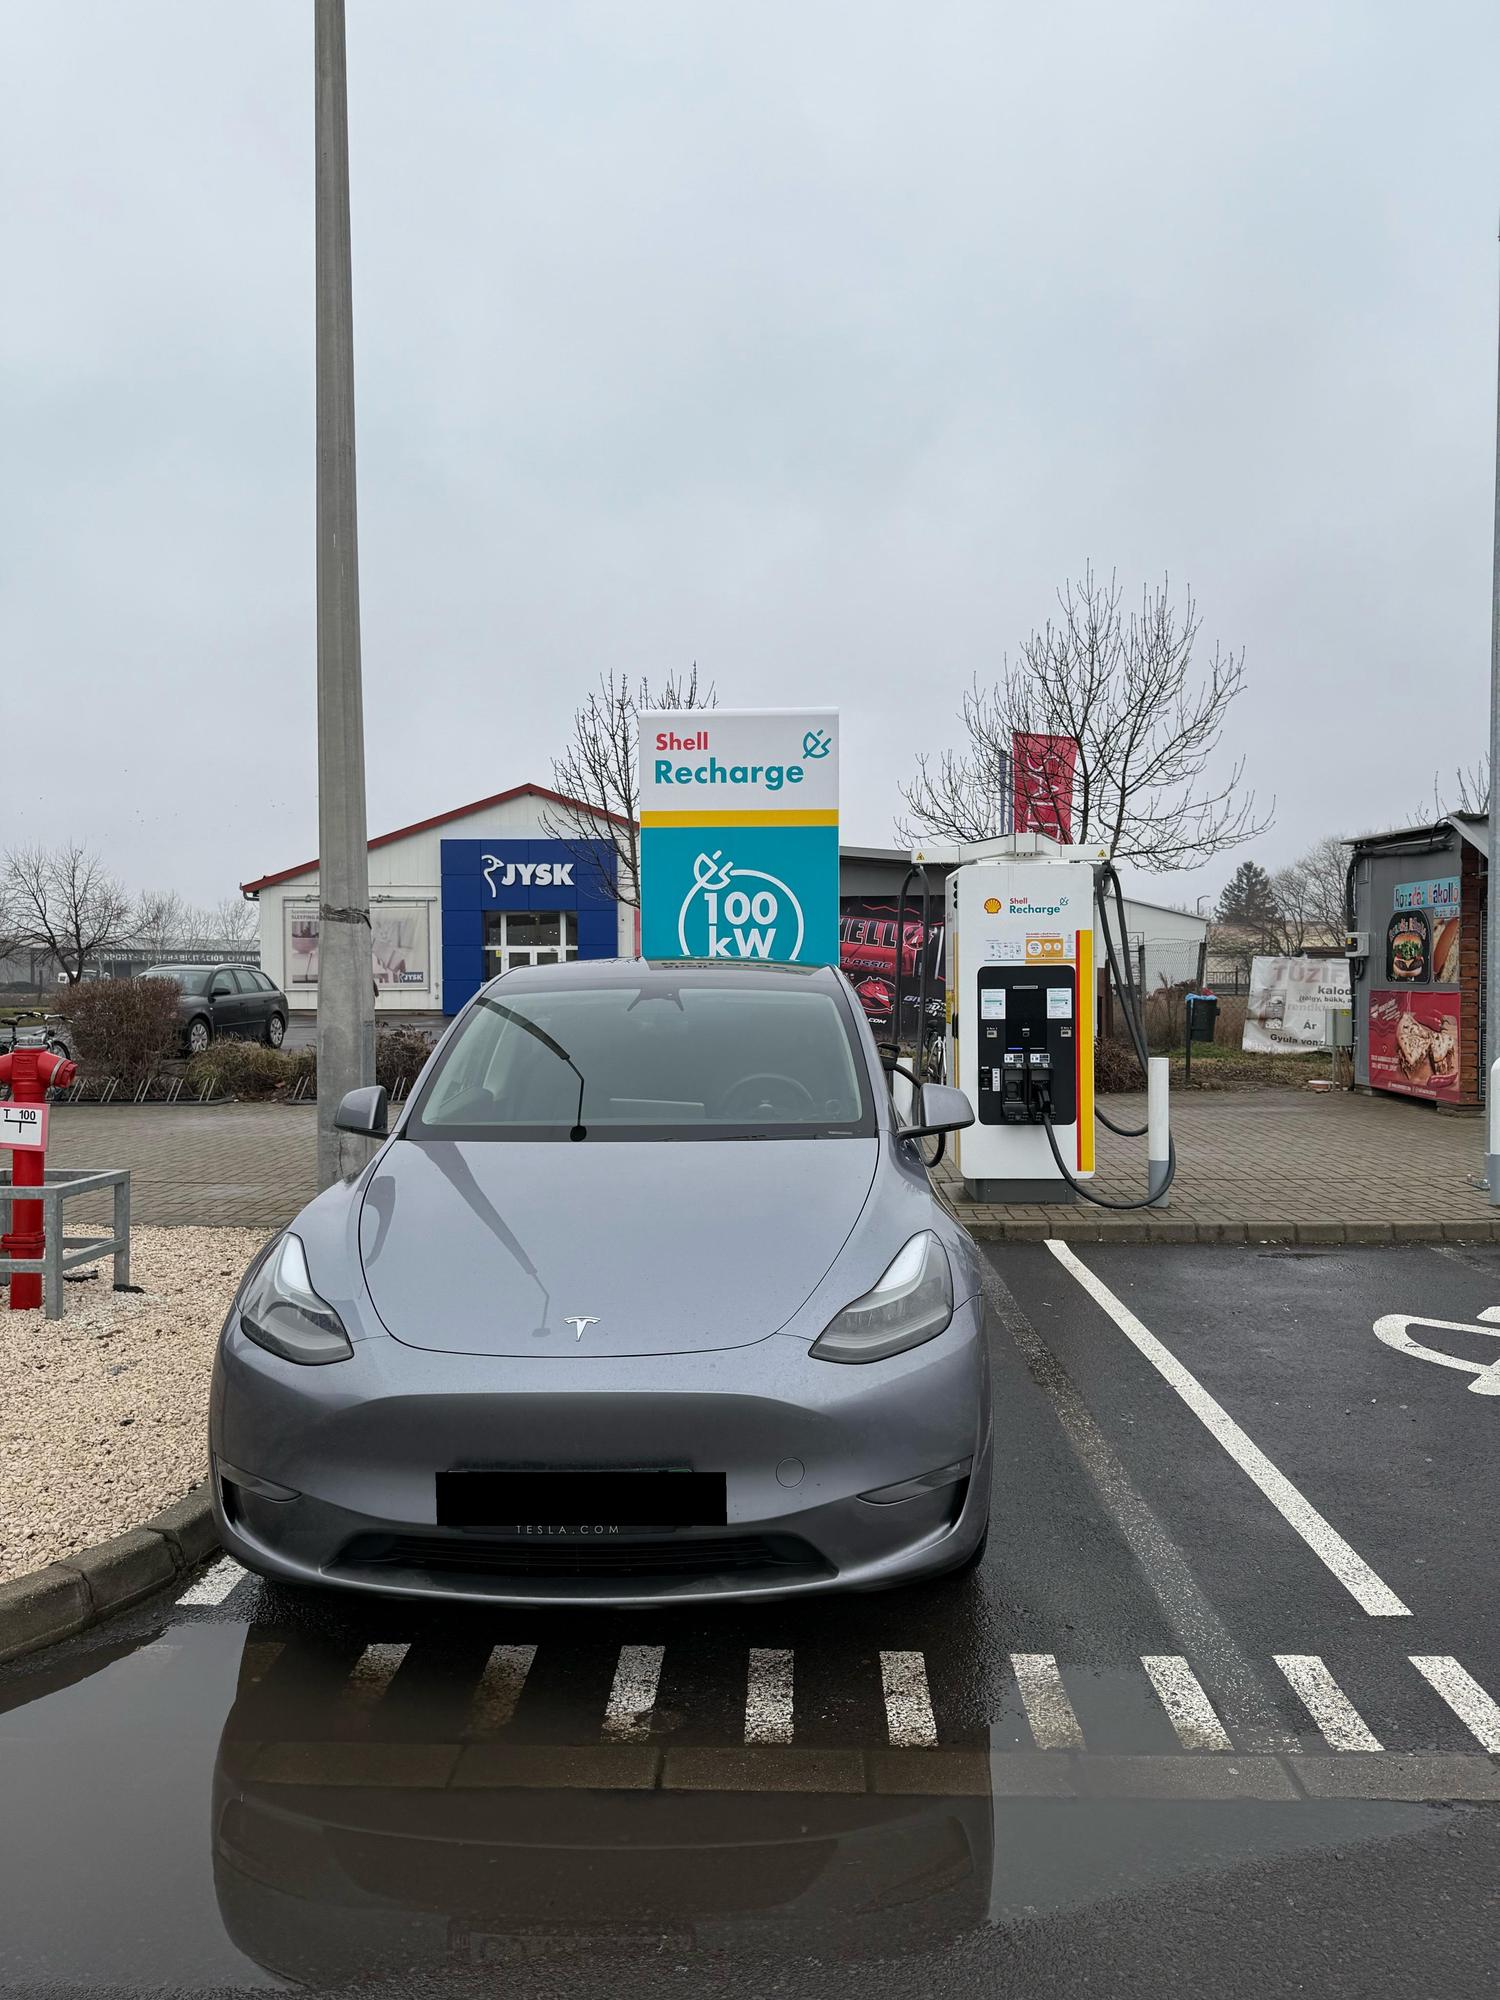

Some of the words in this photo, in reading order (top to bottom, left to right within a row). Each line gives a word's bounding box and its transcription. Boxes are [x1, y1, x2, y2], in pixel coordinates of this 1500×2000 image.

[656, 732, 709, 751] Shell
[655, 757, 804, 791] Recharge
[501, 863, 575, 886] JYSK
[704, 891, 778, 925] 100
[1009, 897, 1028, 905] Shell
[1009, 904, 1061, 915] Recharge
[708, 925, 777, 959] kW
[1270, 1033, 1298, 1045] Gyula
[4, 1109, 10, 1118] T
[19, 1110, 36, 1120] 100
[516, 1525, 619, 1534] TESLA.COM
